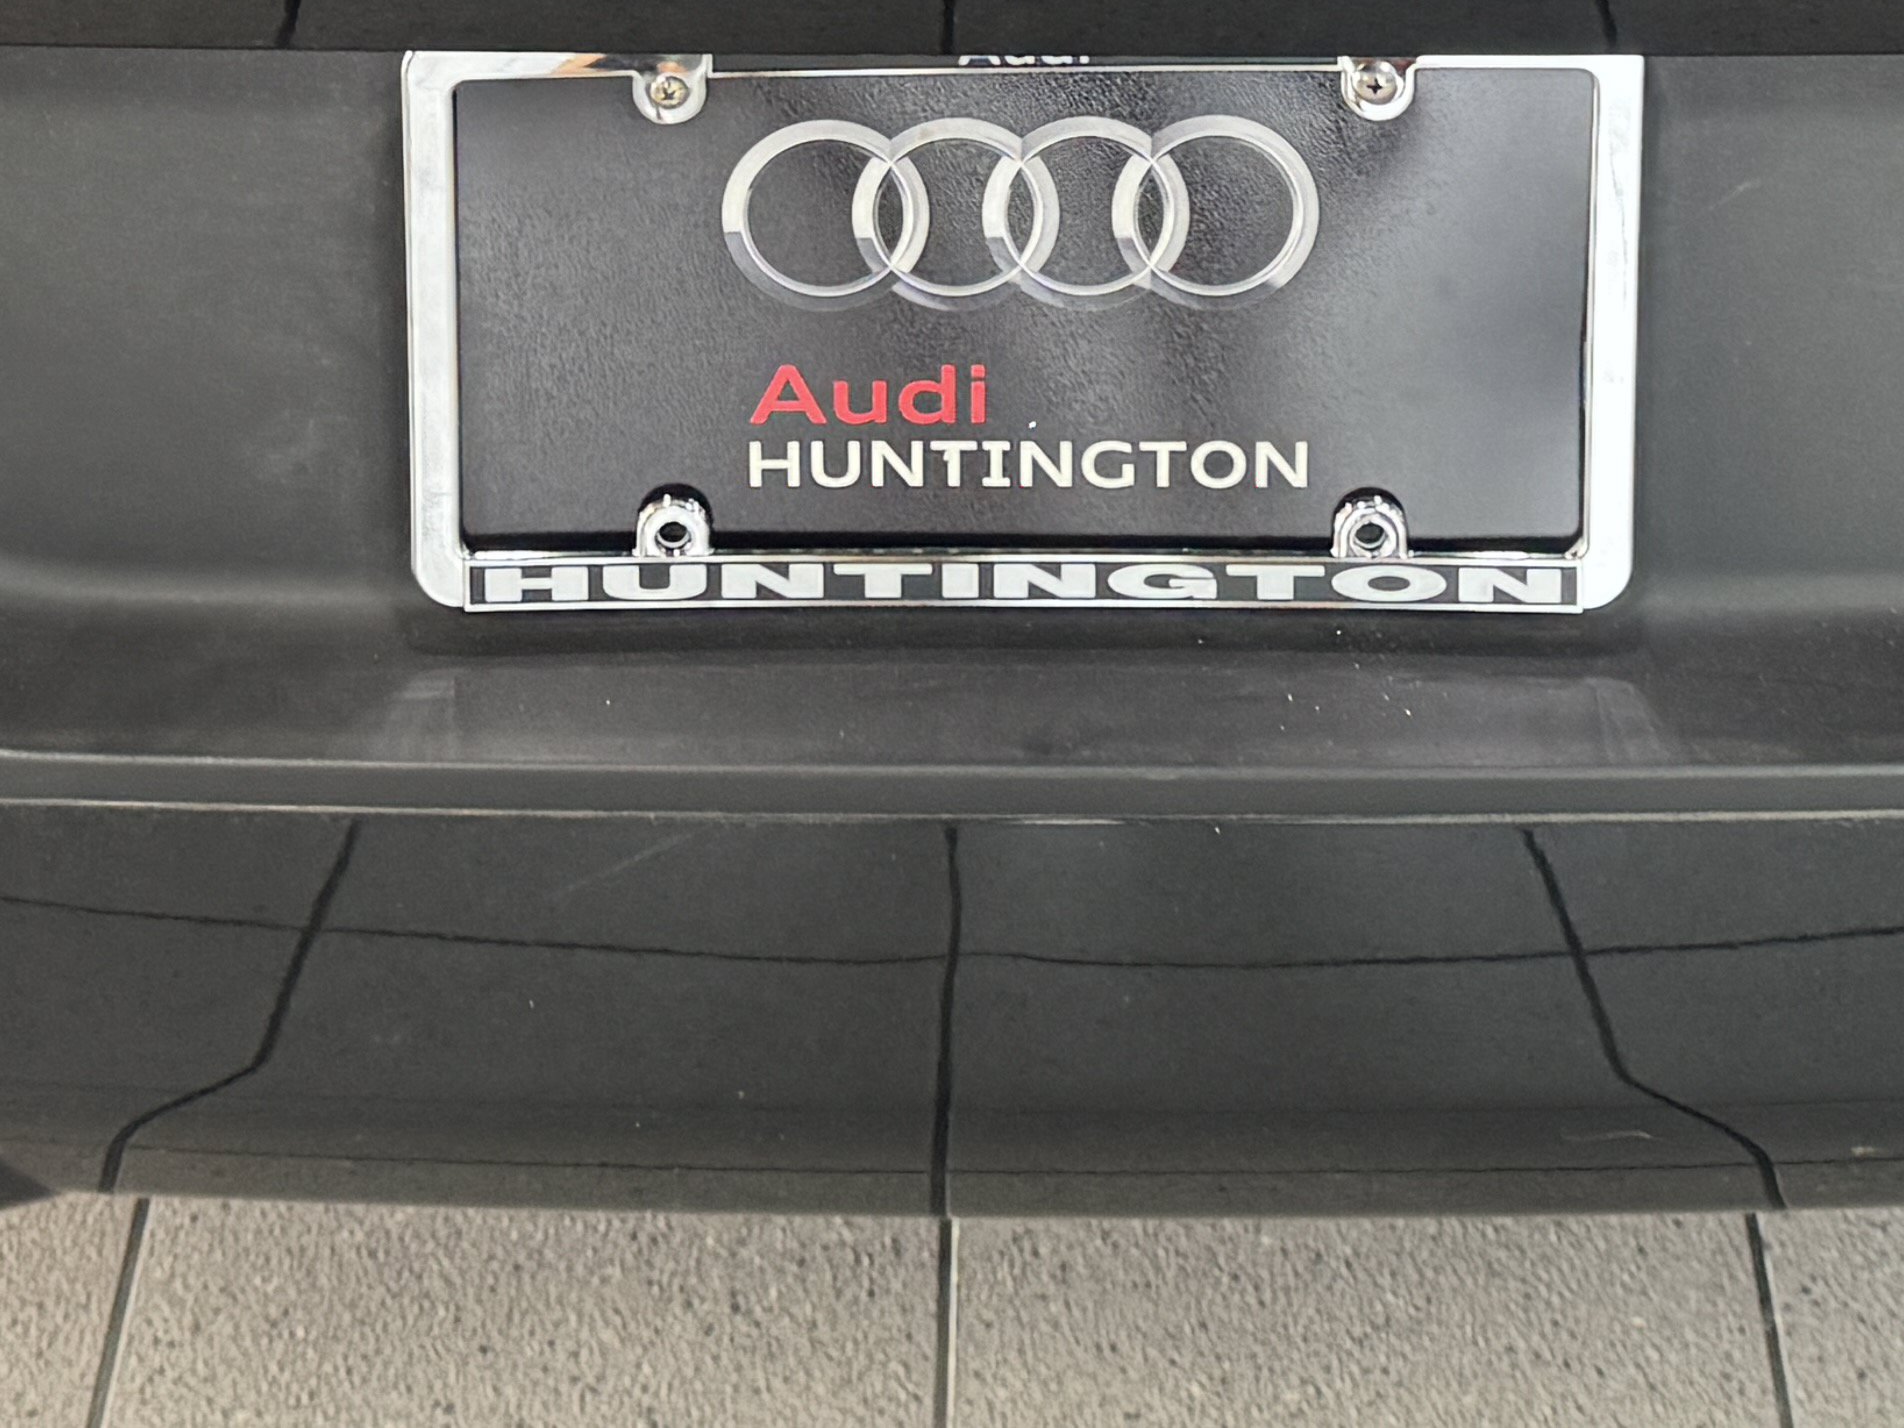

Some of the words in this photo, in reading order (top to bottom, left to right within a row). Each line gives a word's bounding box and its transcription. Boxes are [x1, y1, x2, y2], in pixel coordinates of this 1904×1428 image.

[749, 363, 987, 425] Audi
[748, 440, 1310, 490] HUNTINGTON
[484, 561, 1563, 604] HUNTINGTON
